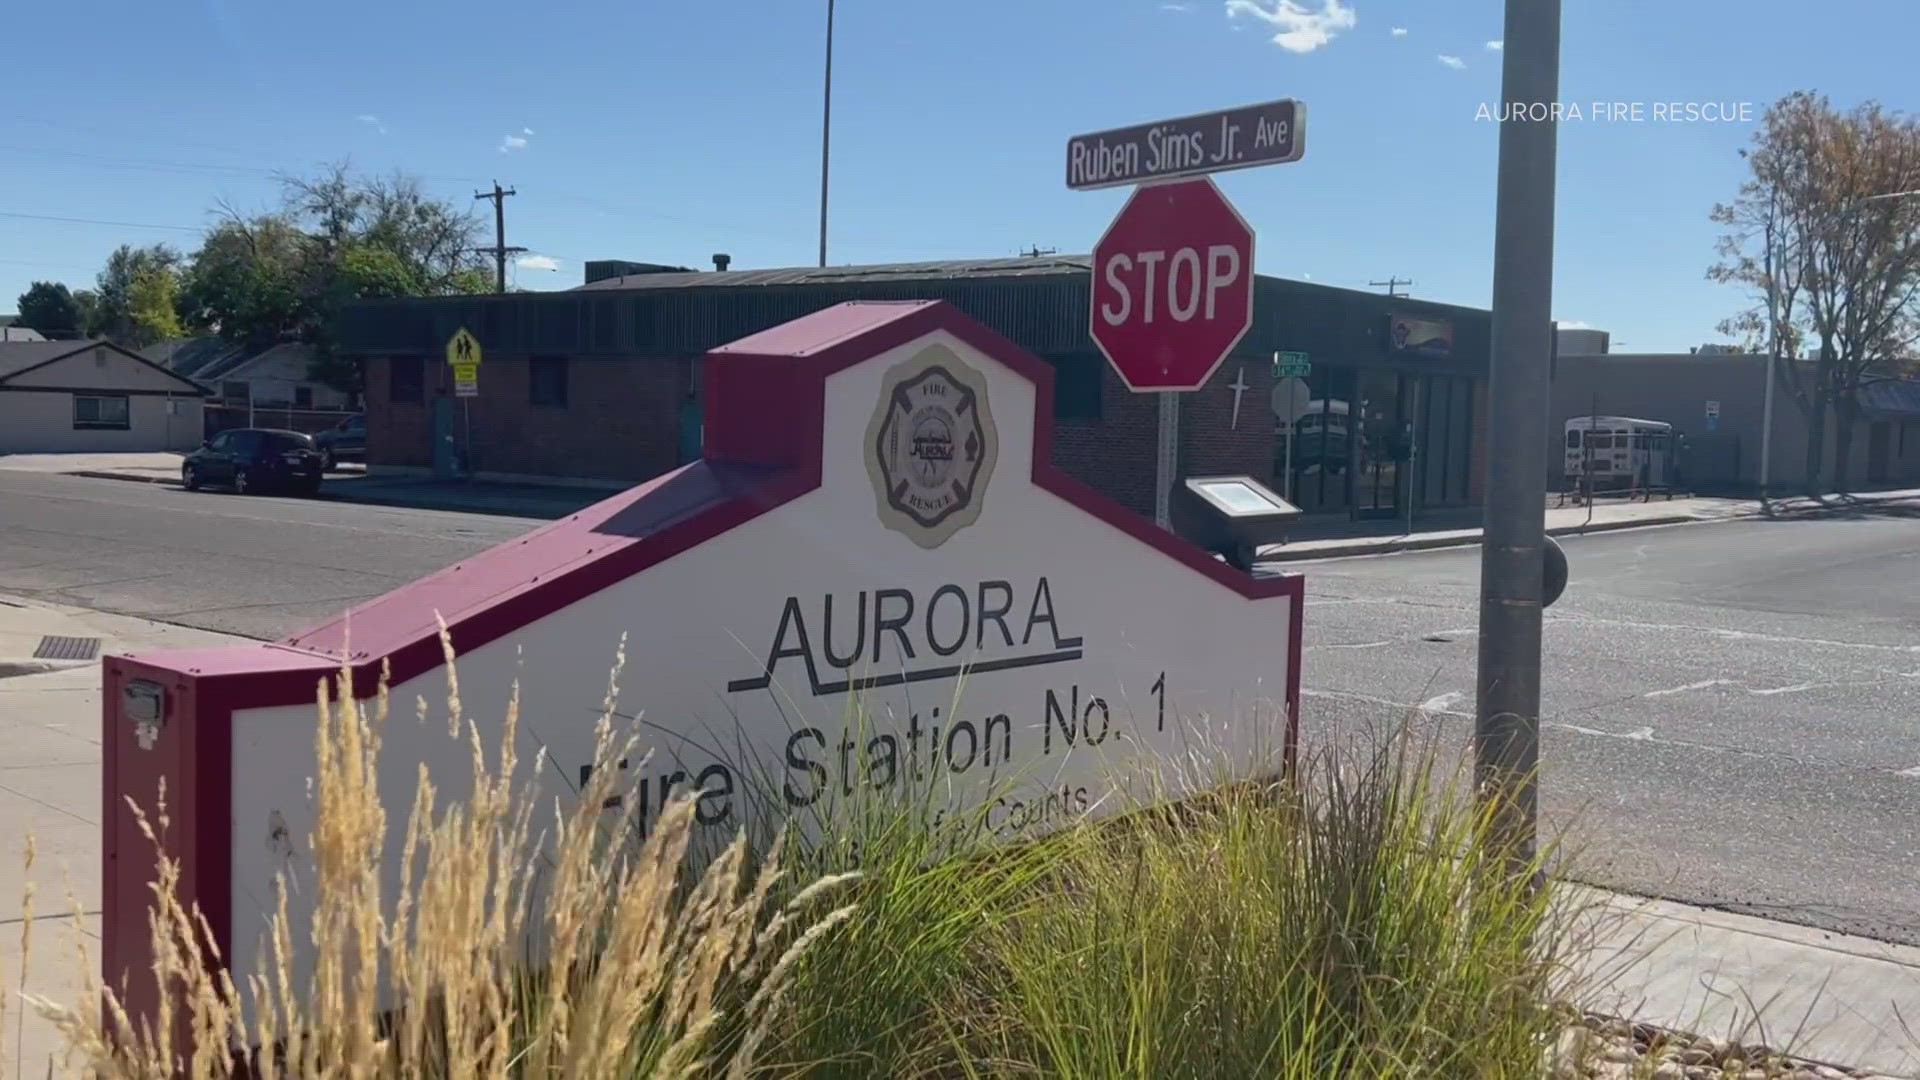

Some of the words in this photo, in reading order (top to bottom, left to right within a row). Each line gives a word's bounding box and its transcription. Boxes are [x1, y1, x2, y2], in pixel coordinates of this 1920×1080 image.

[1071, 138, 1139, 184] Ruben
[1146, 126, 1204, 172] Sims
[1211, 115, 1244, 163] Jr.
[1255, 116, 1289, 149] Ave
[1101, 244, 1241, 327] STOP
[922, 383, 947, 397] FIRE
[909, 494, 953, 510] RESCUE
[728, 577, 1084, 696] AURORA
[782, 706, 1012, 807] Station
[1043, 685, 1122, 756] No.
[1150, 671, 1165, 733] 1
[984, 786, 1088, 834] Counts
